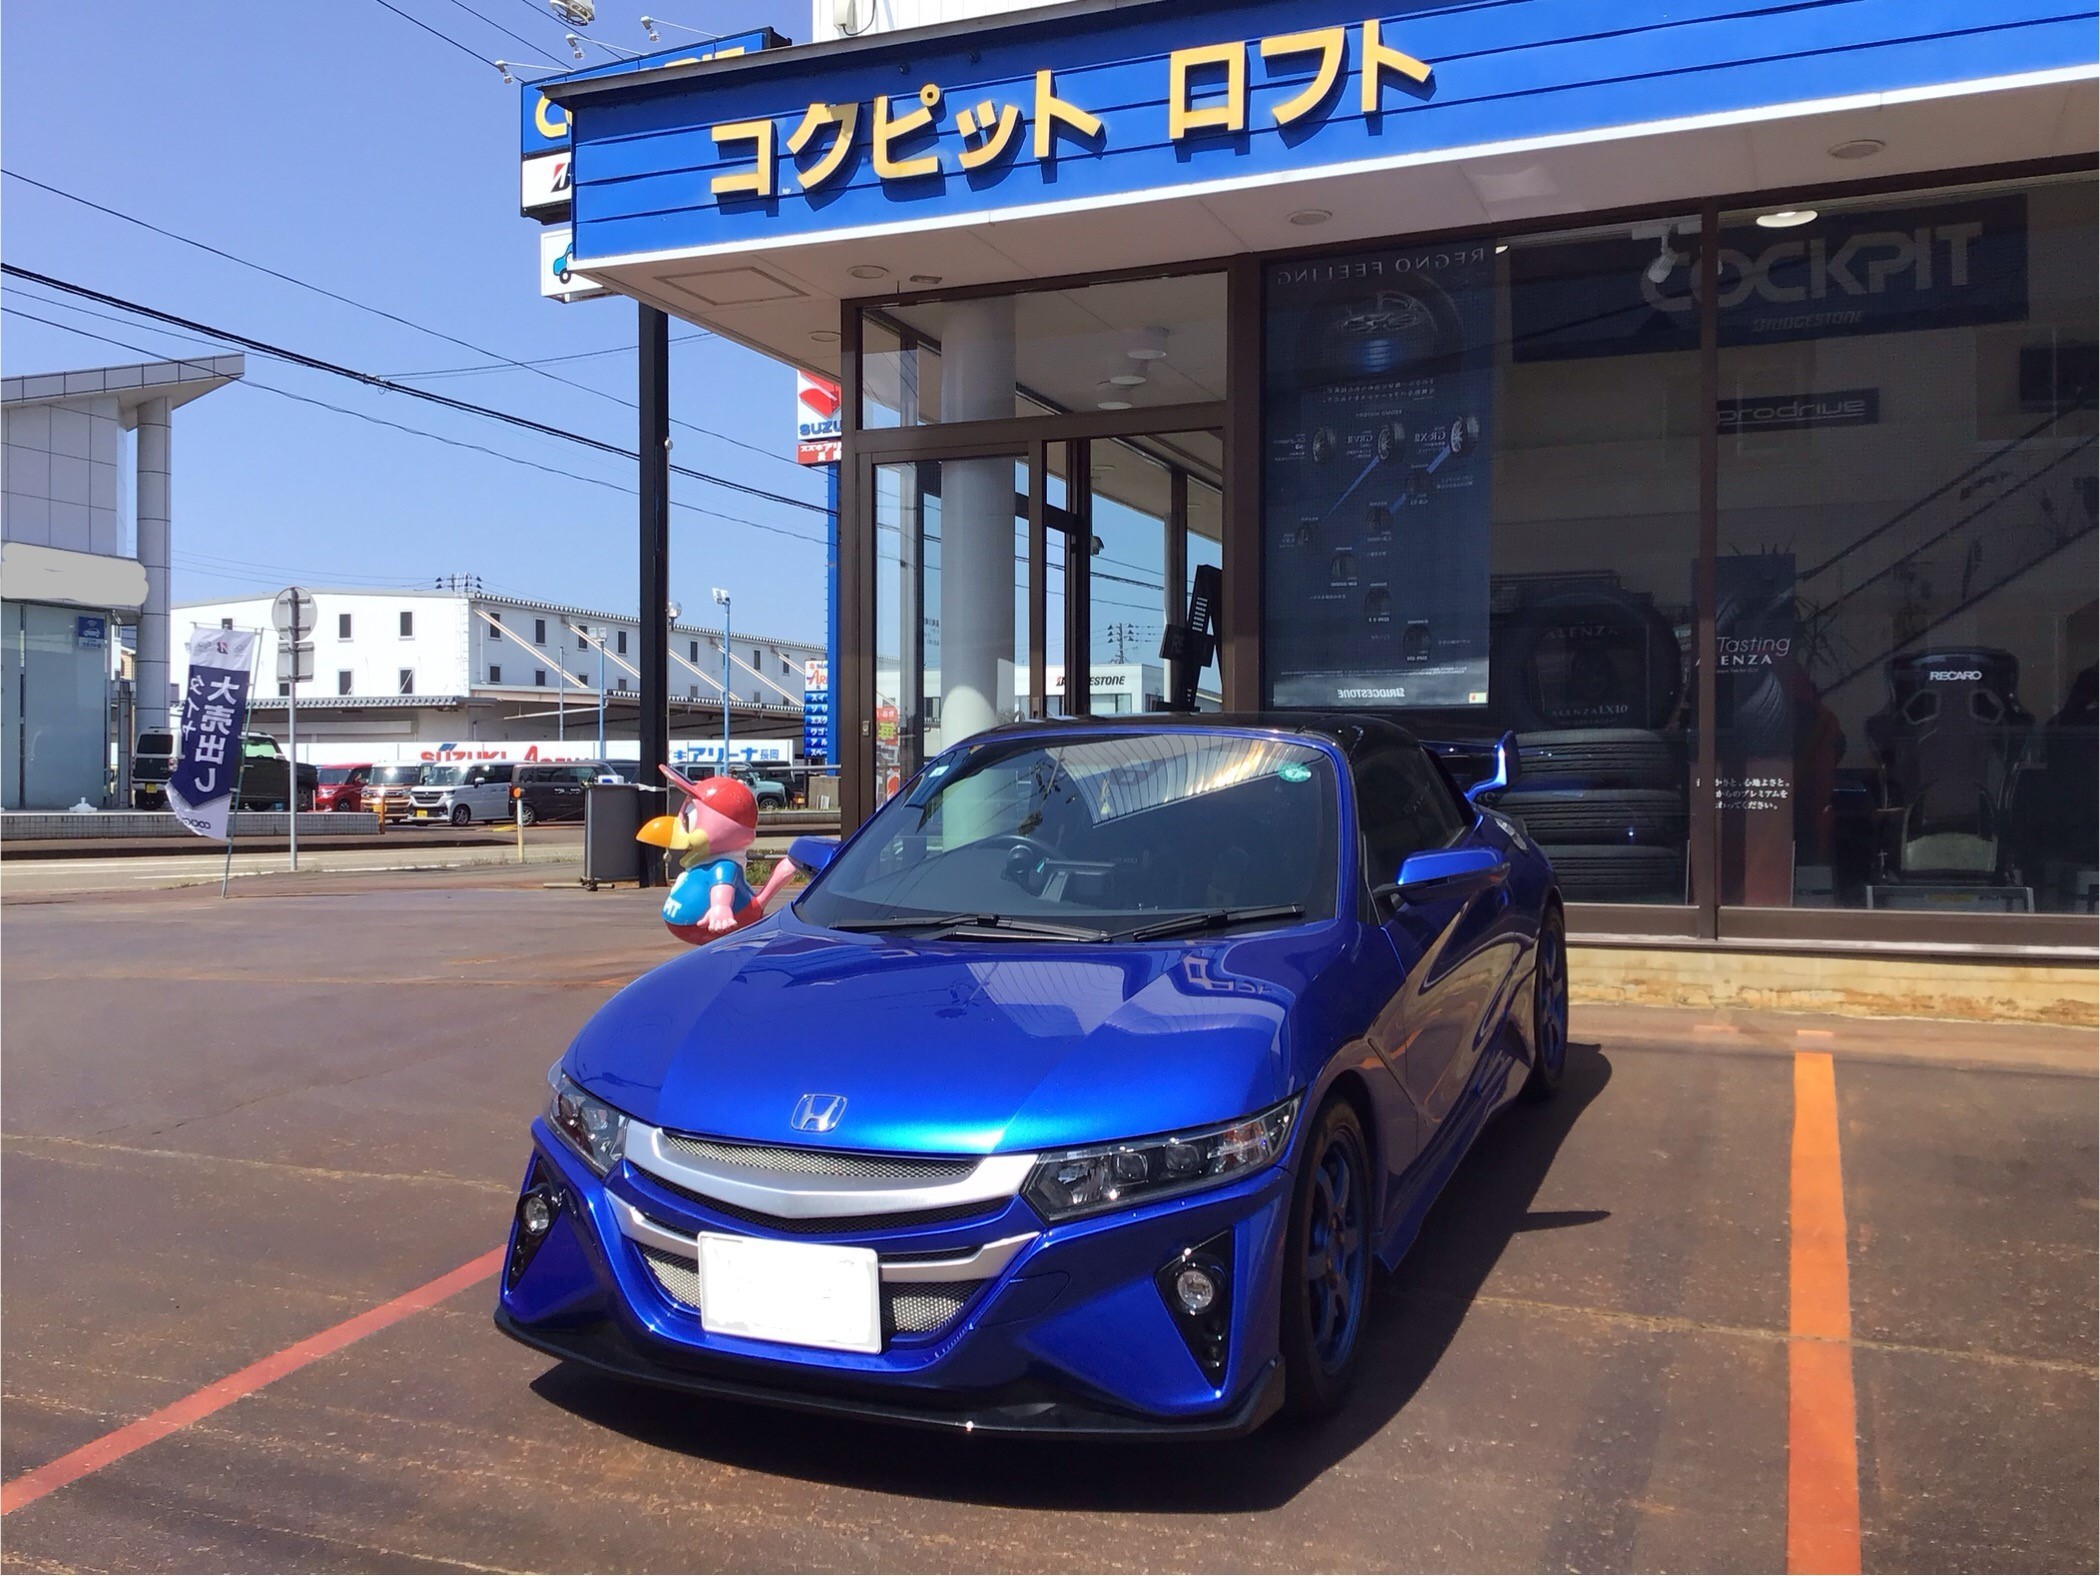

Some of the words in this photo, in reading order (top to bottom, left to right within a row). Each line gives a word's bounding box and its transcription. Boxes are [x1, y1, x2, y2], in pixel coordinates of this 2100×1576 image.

[711, 70, 1102, 196] コクピット
[1169, 19, 1433, 140] ロフト
[1640, 220, 1983, 312] COCKPIT
[1752, 309, 1867, 333] BRIDGESTONE
[1716, 636, 1791, 657] Tasting
[1695, 654, 1773, 667] ENZA
[1929, 670, 1982, 681] RECARO
